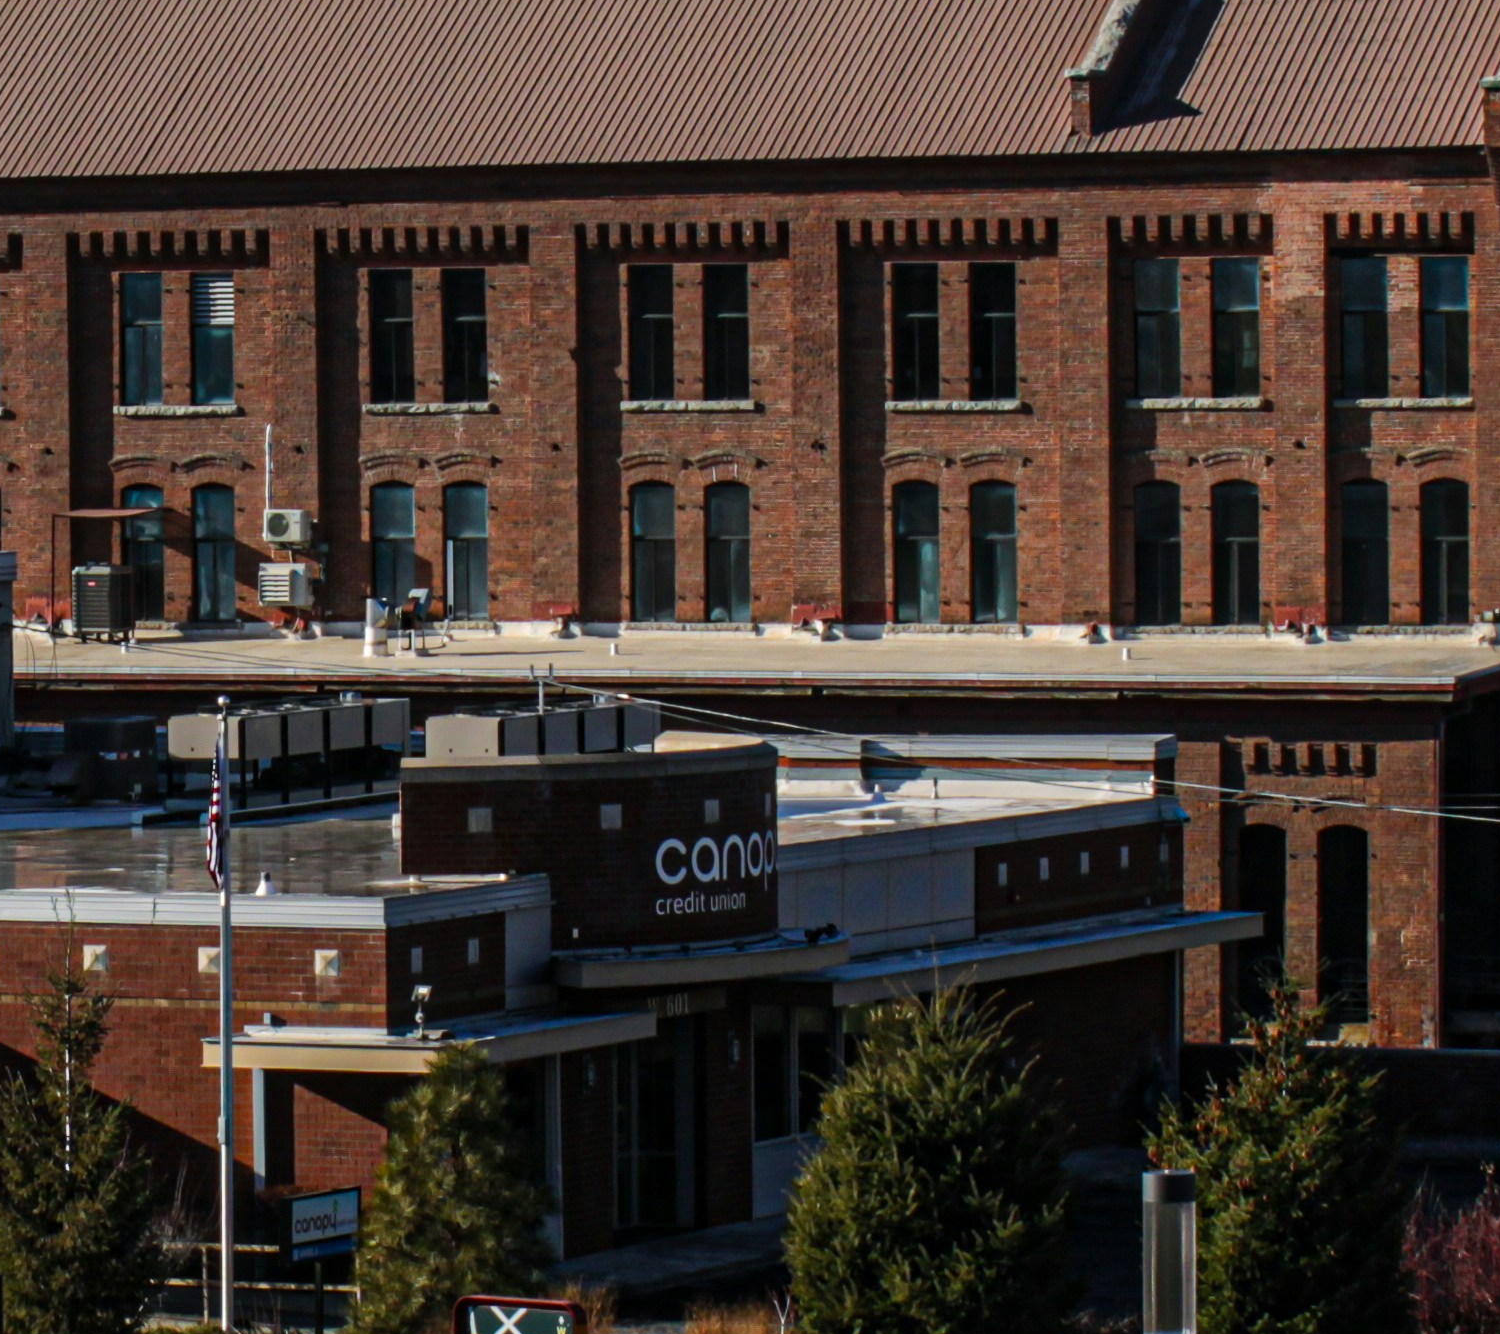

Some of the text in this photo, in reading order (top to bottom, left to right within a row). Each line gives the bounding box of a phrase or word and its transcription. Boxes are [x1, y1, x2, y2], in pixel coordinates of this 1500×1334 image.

[655, 830, 775, 892] canop
[656, 888, 746, 915] credit union
[294, 1213, 337, 1234] canopy
